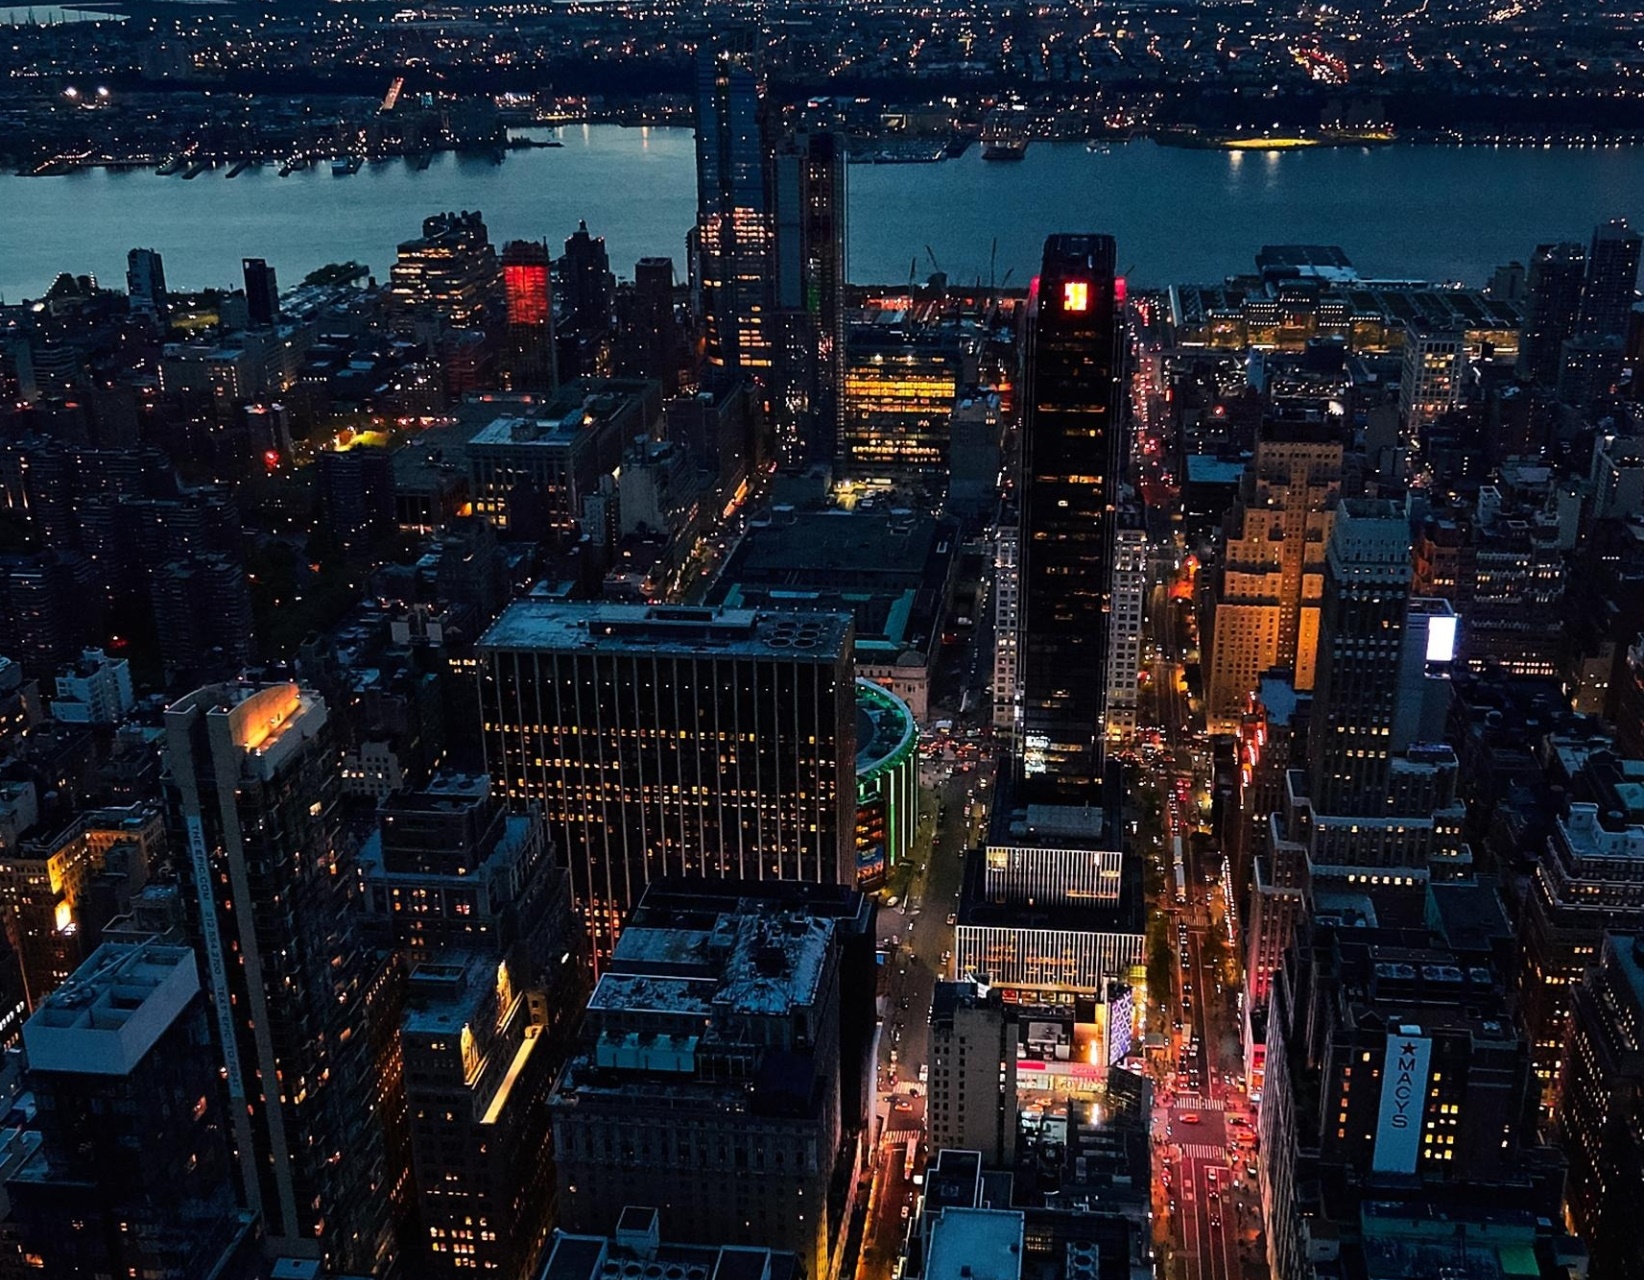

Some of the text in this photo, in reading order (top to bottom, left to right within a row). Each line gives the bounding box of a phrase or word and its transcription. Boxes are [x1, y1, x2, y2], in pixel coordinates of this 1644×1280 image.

[191, 825, 201, 844] THE
[195, 849, 210, 900] EPIC.COM
[227, 1043, 235, 1058] TO
